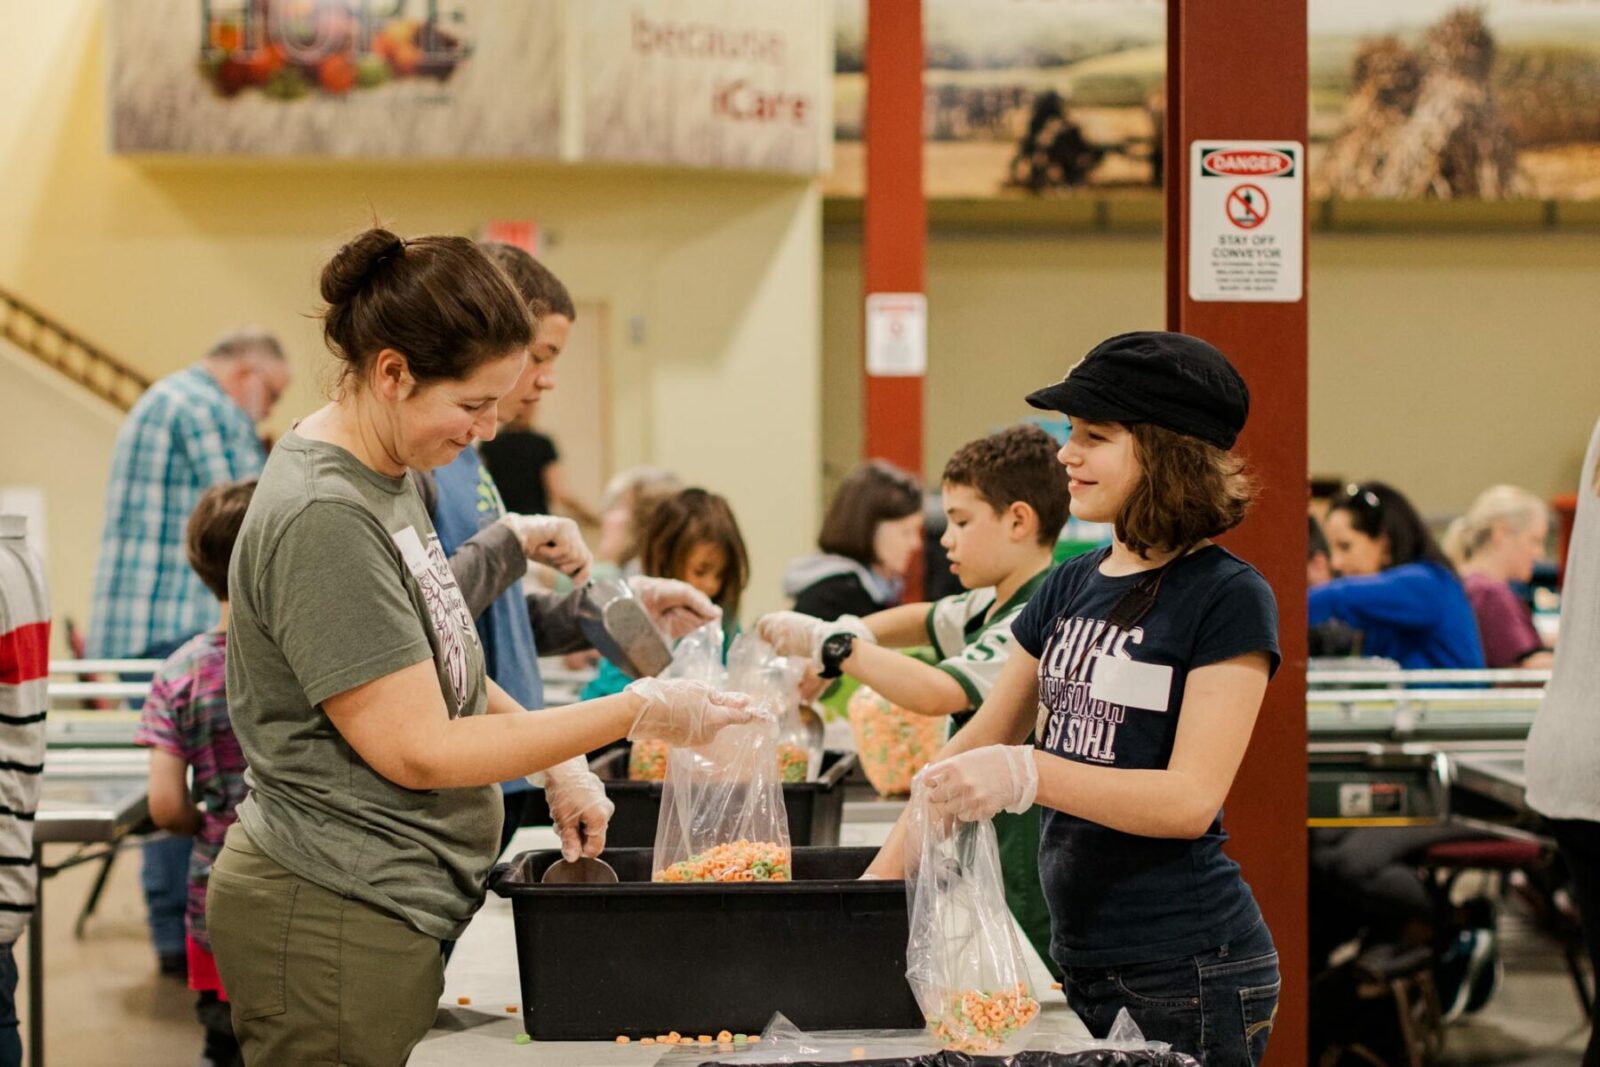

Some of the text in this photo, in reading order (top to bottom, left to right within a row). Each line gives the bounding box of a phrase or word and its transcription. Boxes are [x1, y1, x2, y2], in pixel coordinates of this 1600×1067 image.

[631, 11, 786, 62] because
[713, 79, 809, 124] iCare
[1213, 154, 1281, 171] DANGER
[1212, 248, 1281, 259] CONVEYOR
[1219, 235, 1275, 245] STAY OFF
[1063, 717, 1116, 760] THIS
